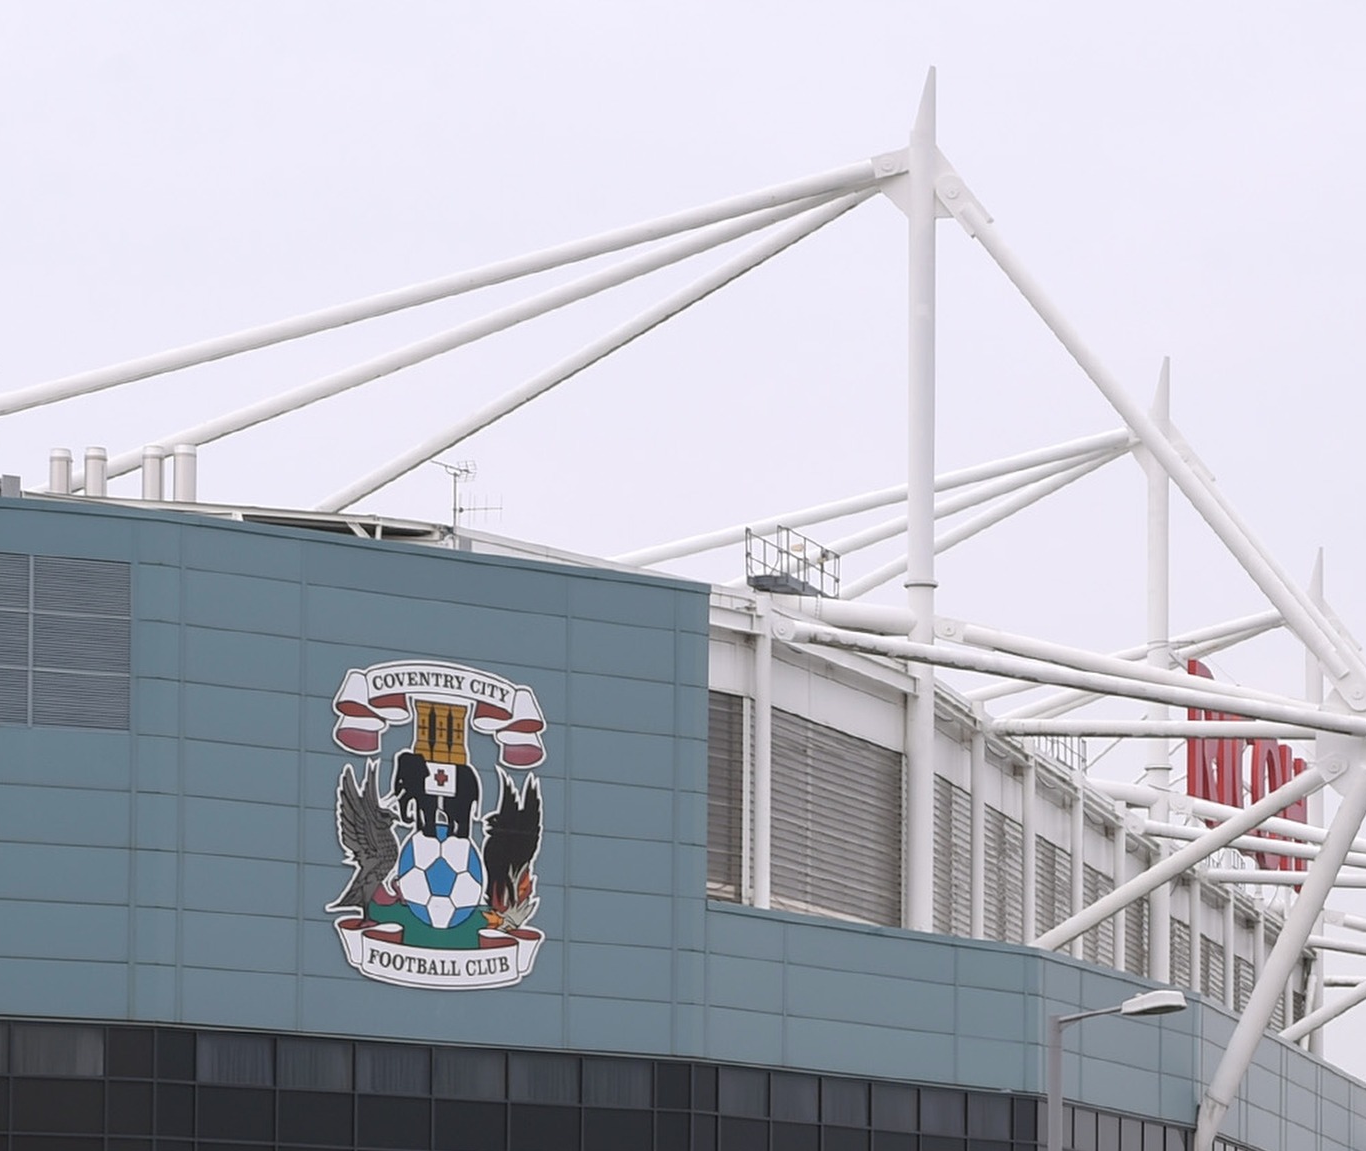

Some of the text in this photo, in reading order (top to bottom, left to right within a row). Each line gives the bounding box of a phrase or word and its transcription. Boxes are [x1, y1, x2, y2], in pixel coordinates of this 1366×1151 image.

[372, 671, 510, 702] COVENTRY CITY
[368, 949, 510, 976] FOOTBALL CLUB
